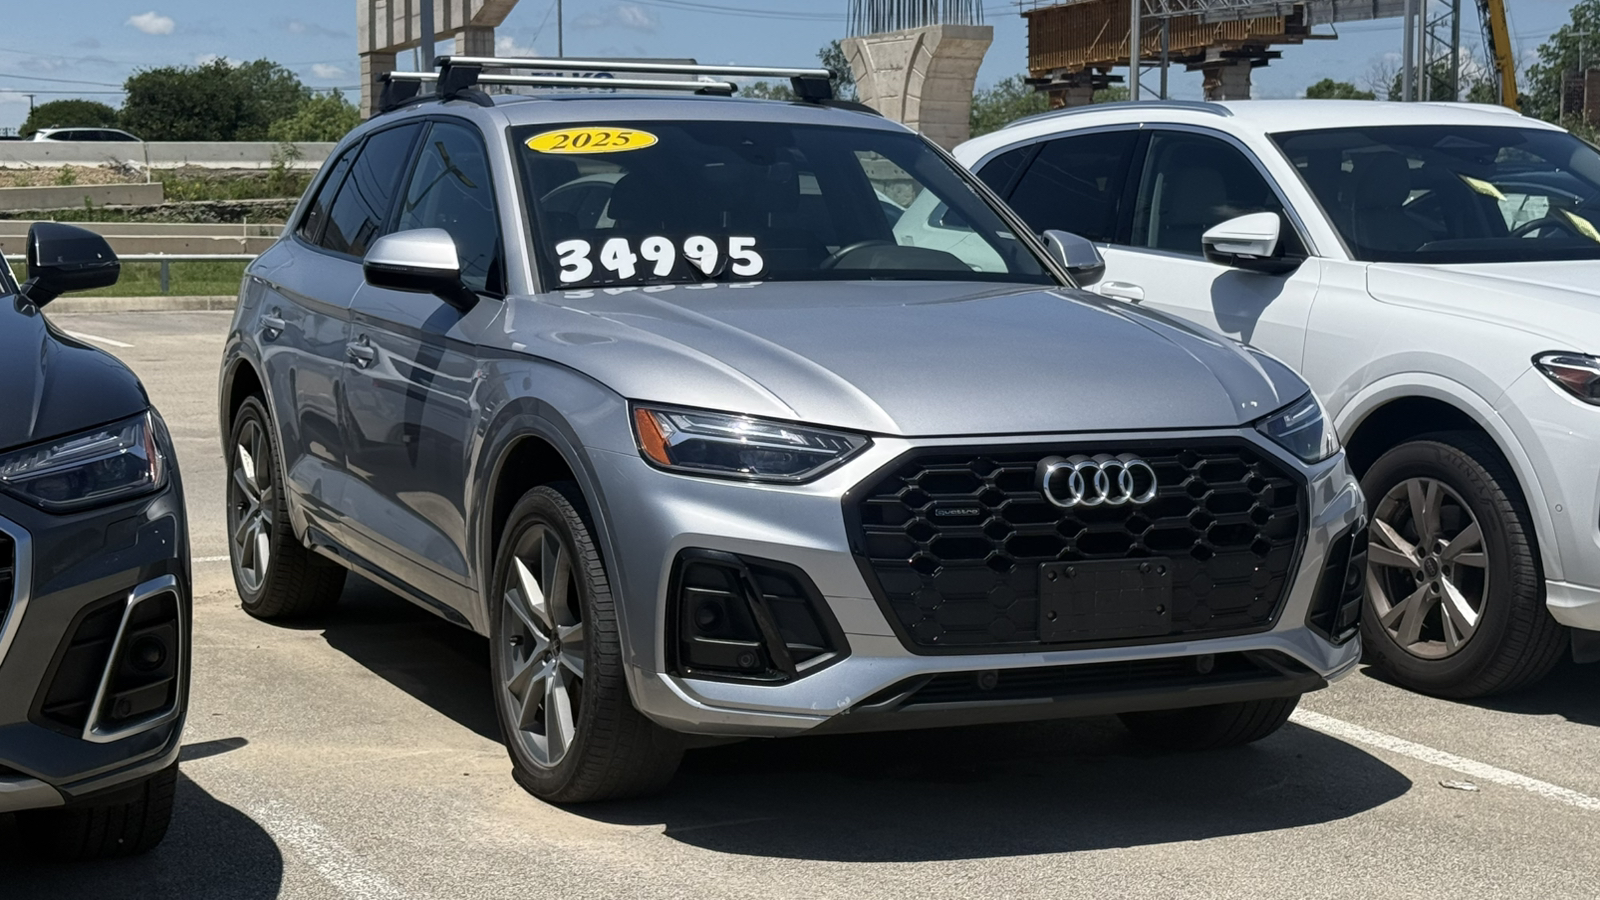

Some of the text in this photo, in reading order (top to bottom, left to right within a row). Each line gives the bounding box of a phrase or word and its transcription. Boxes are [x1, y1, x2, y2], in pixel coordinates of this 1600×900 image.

[549, 132, 633, 151] 2025
[555, 235, 764, 283] 34995
[1443, 454, 1485, 494] ALENZA
